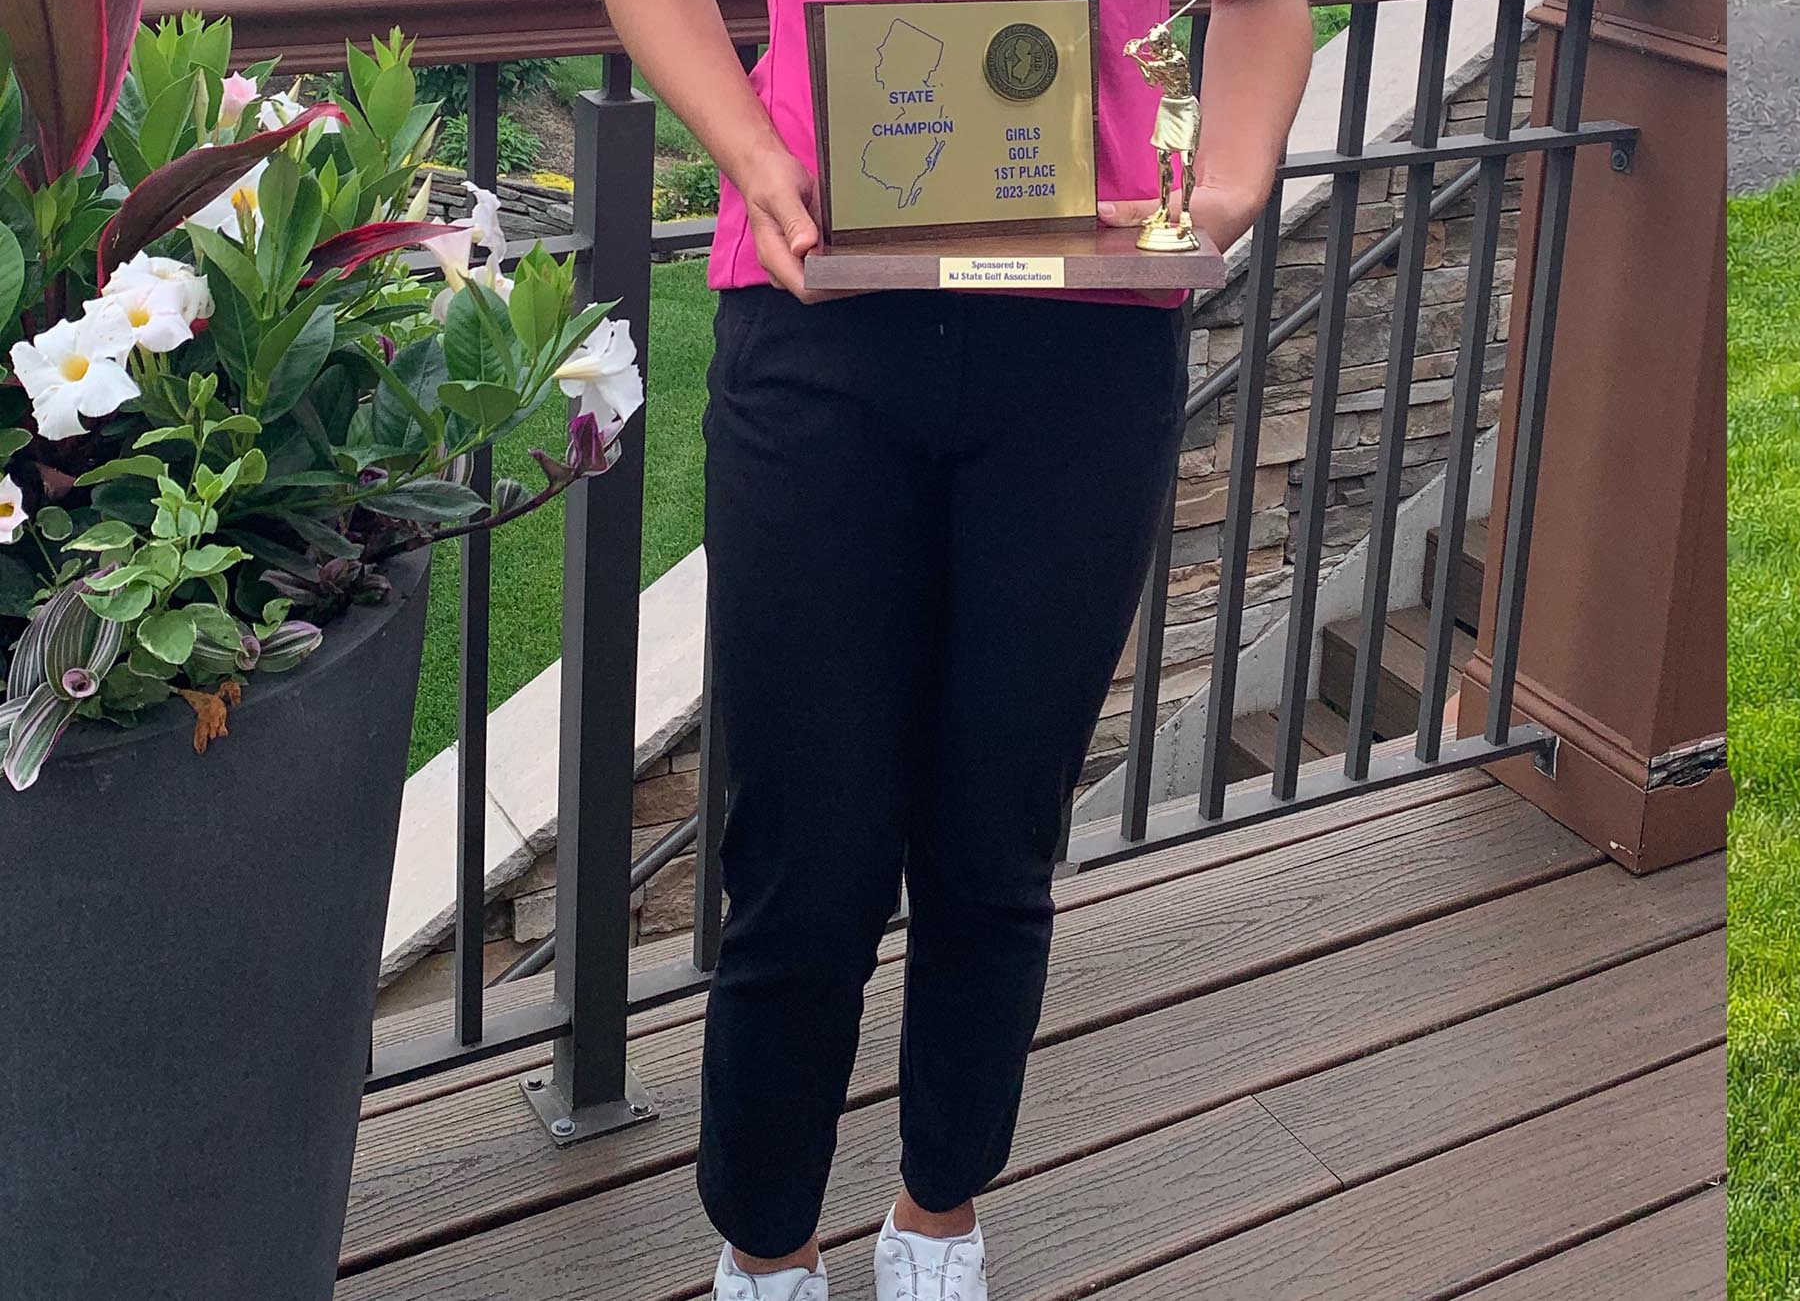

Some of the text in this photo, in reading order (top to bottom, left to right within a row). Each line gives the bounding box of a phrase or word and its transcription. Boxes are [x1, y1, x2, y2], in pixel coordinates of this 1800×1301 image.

[888, 89, 934, 104] STATE
[872, 120, 954, 137] CHAMPION
[1005, 127, 1041, 142] GIRLS
[1008, 146, 1040, 161] GOLF
[993, 164, 1056, 180] 1ST PLACE
[995, 183, 1056, 199] 2023-2024
[971, 260, 1028, 271] Sponsored by:
[949, 272, 1052, 281] NJ State Golf Association
